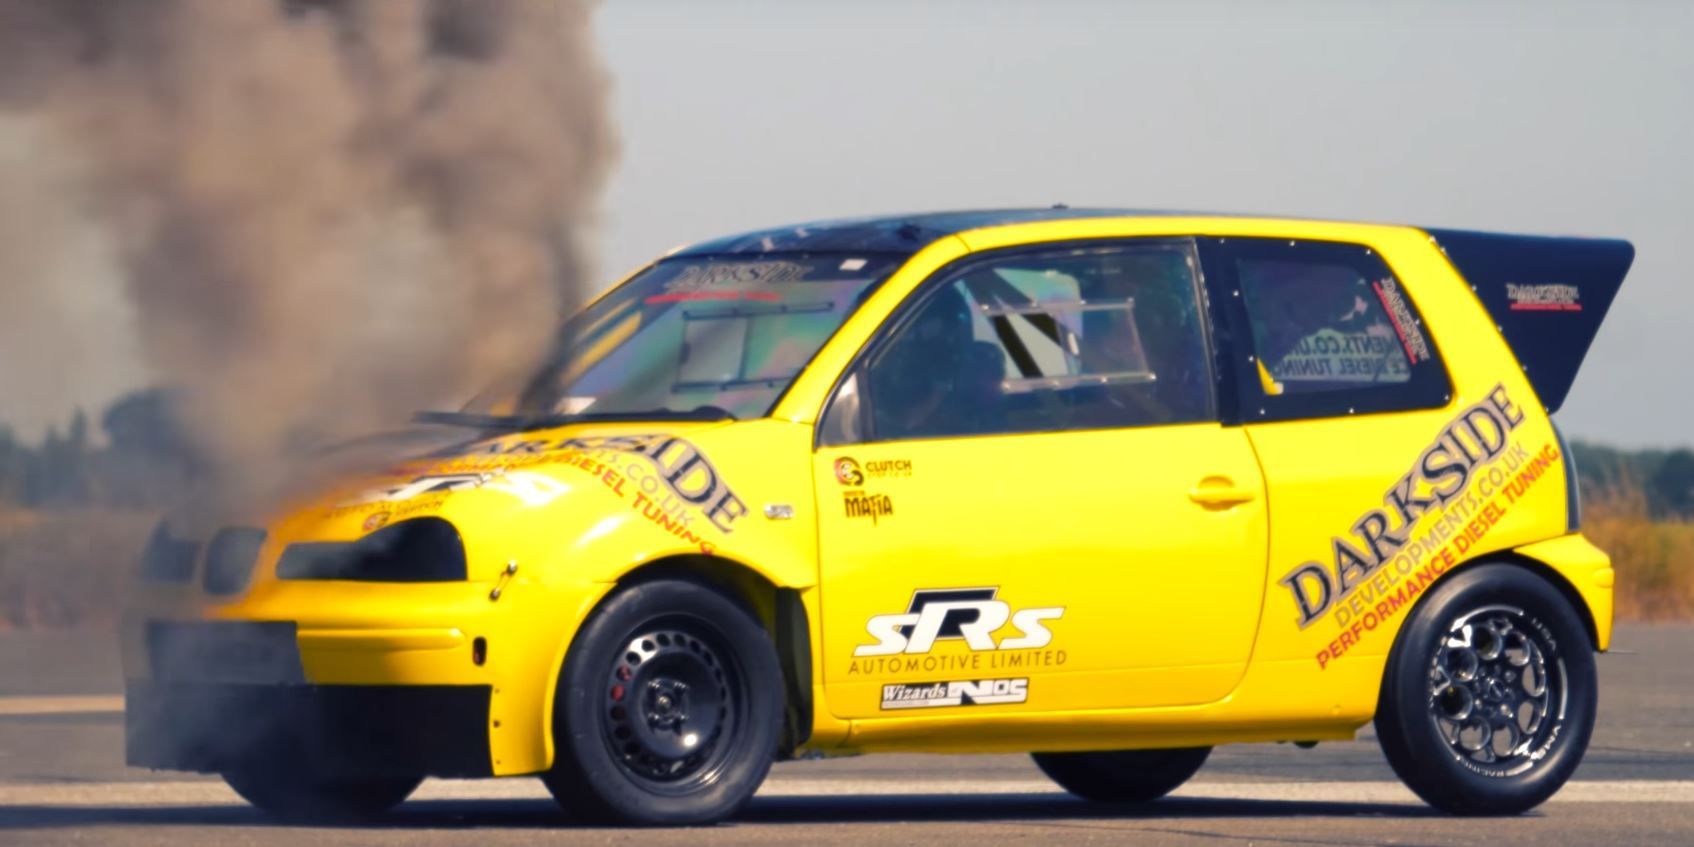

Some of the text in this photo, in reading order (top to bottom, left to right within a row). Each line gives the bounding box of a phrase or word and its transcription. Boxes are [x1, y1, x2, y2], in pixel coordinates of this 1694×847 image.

[865, 460, 913, 473] CLUTCH
[632, 491, 717, 556] TUNING
[1278, 382, 1524, 630] DARKSIDE
[1334, 441, 1529, 629] DEVELOPMENTS.CO.UK
[1315, 443, 1560, 670] PERFORMANCE DIESEL TUNING
[848, 650, 1068, 675] AUTOMOTIVE LIMITED
[883, 682, 947, 701] Wizards
